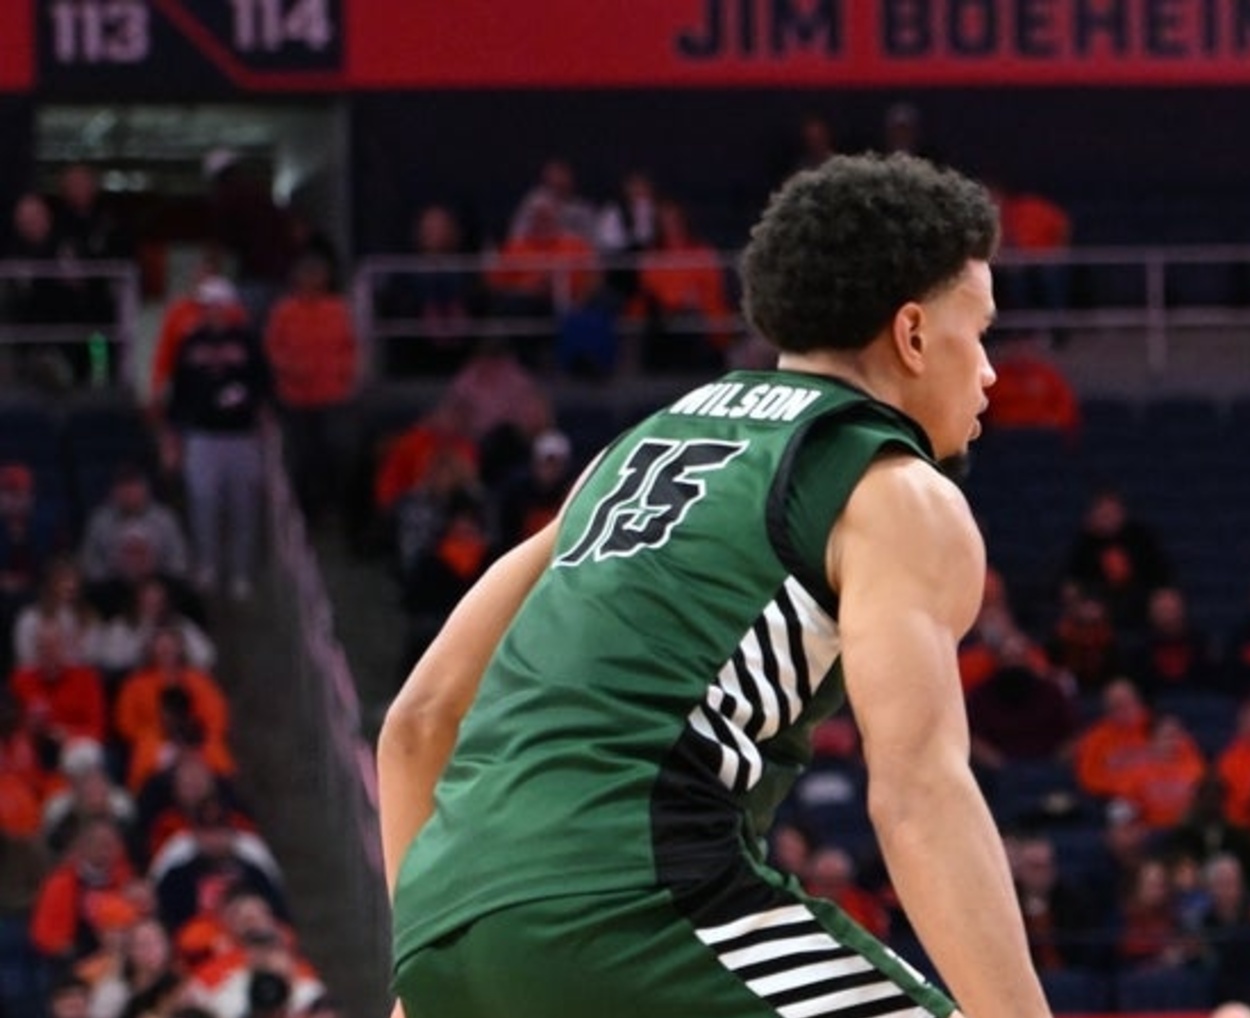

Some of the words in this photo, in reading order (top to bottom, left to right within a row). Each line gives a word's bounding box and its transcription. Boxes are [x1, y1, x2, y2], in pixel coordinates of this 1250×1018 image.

[53, 1, 150, 62] 113
[235, 0, 330, 50] 114
[677, 0, 839, 57] JIM
[668, 383, 821, 421] WILSON
[551, 437, 749, 568] 15
